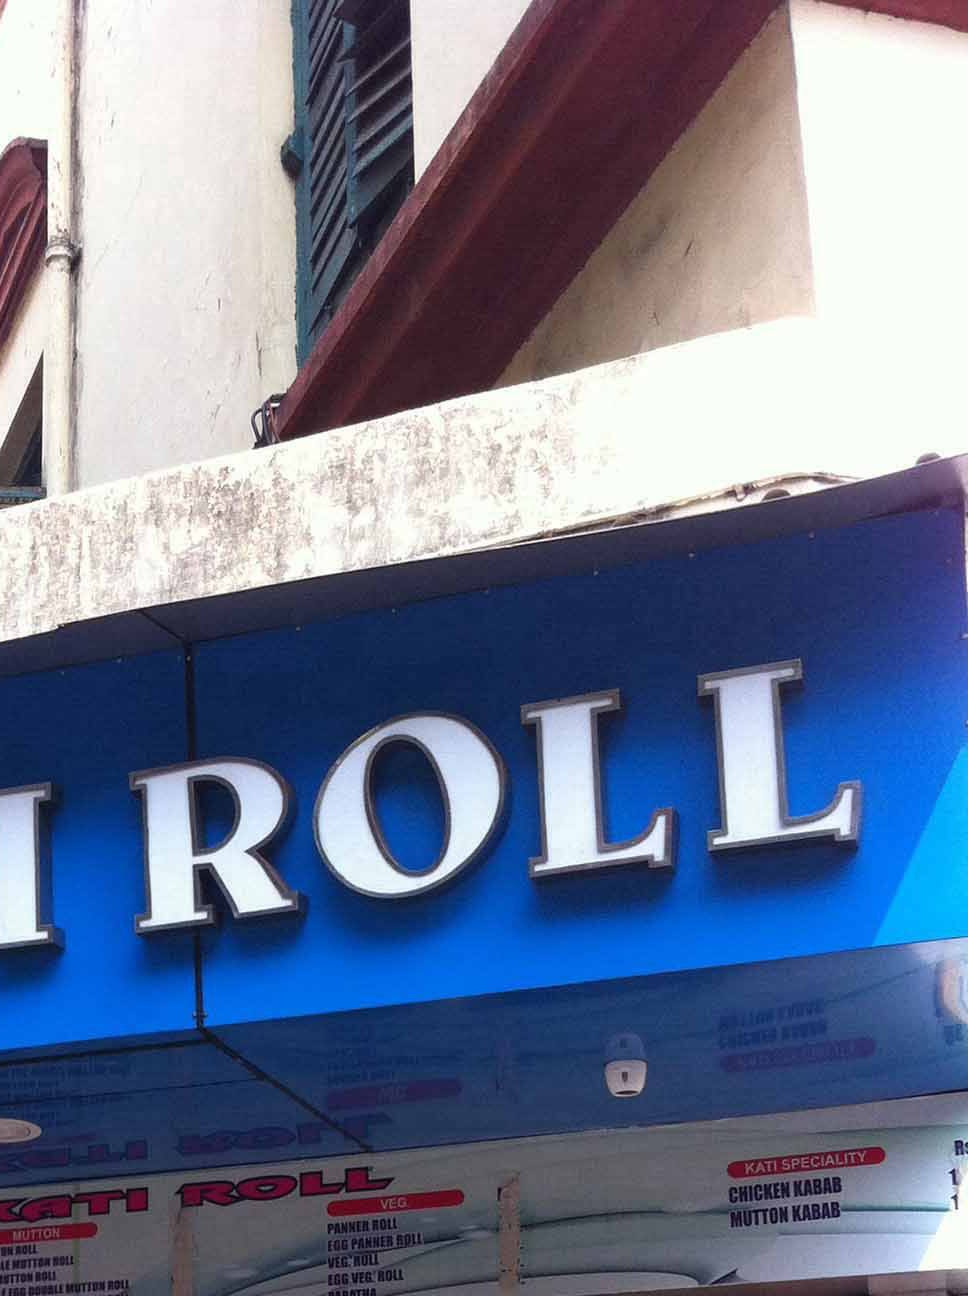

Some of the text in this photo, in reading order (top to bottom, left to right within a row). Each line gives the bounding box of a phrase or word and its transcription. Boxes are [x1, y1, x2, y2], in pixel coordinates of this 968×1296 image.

[129, 658, 860, 934] ROLL
[744, 1150, 867, 1175] KATI SPECIALITY
[175, 1167, 396, 1207] ROLL
[728, 1176, 842, 1204] CHICKEN KABAB
[730, 1201, 841, 1228] MUTTON KABAB
[12, 1227, 61, 1241] MUTTON
[328, 1218, 398, 1234] PANNER ROLL
[15, 1245, 37, 1256] ROLL
[328, 1232, 423, 1252] EGG PANNER ROLL
[12, 1258, 50, 1270] MUTTON
[53, 1256, 74, 1267] ROLL
[353, 1254, 379, 1267] ROLL
[35, 1271, 56, 1282] ROLL
[328, 1274, 348, 1286] EGG
[378, 1269, 404, 1281] ROLL
